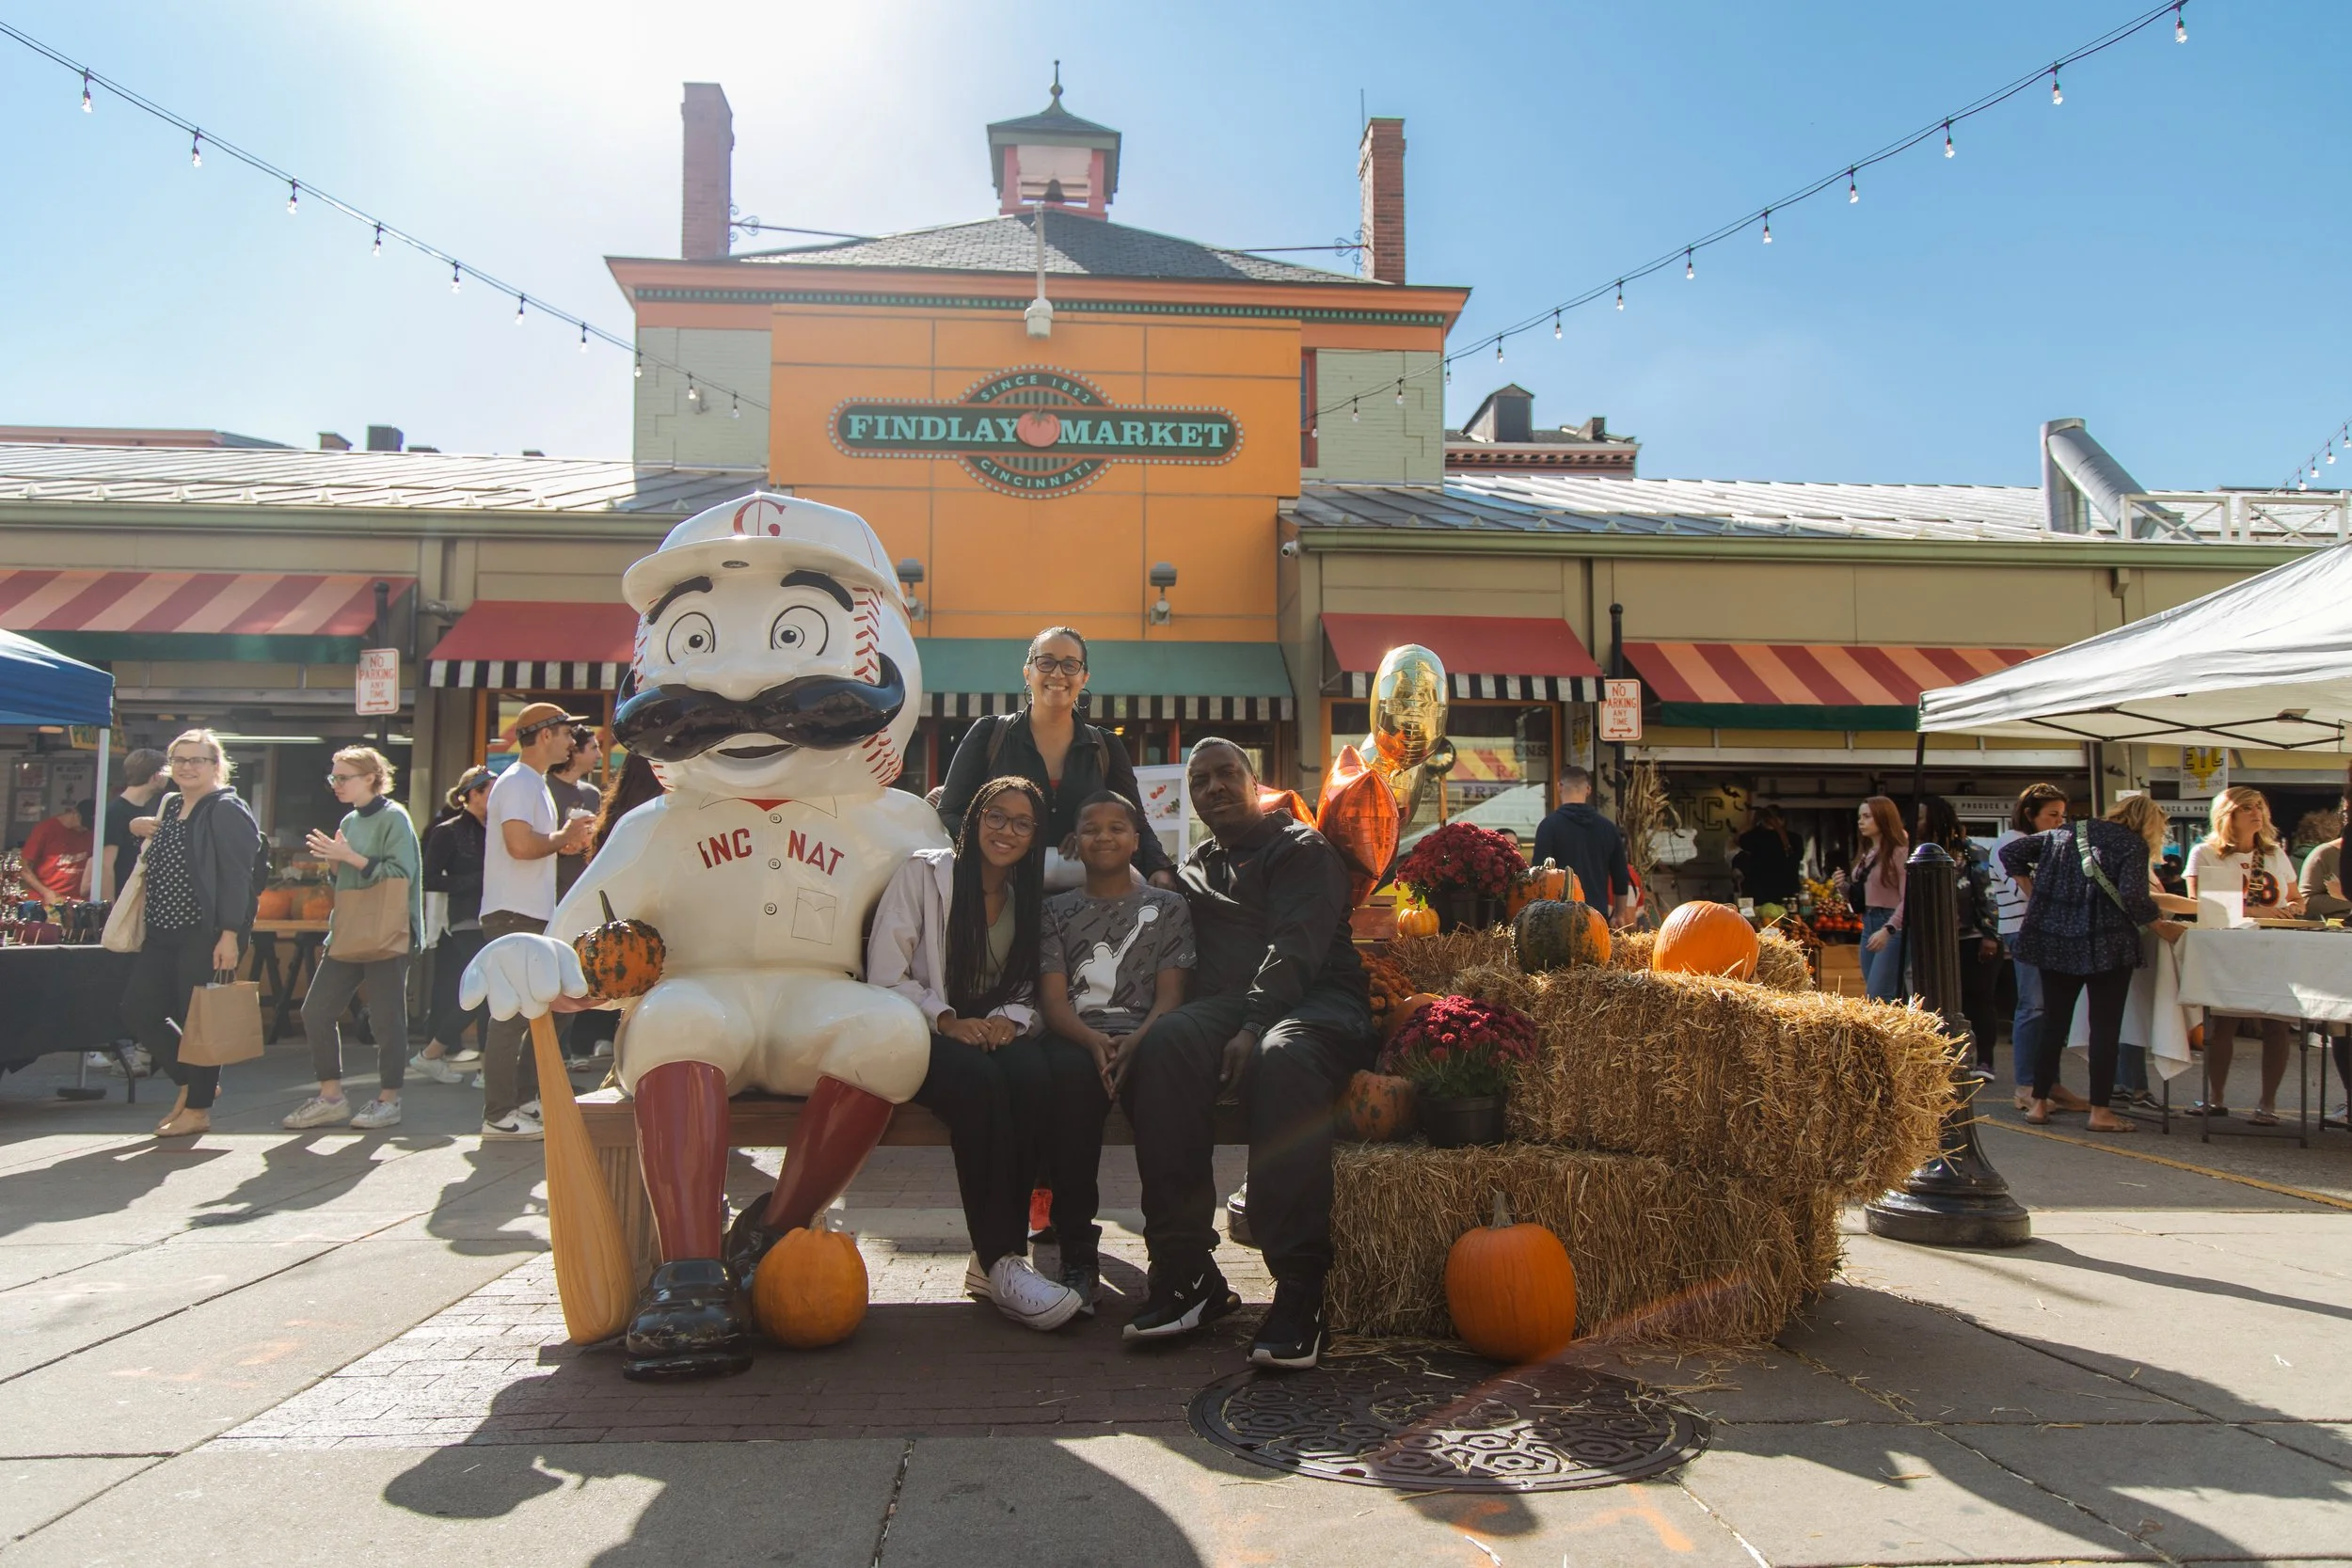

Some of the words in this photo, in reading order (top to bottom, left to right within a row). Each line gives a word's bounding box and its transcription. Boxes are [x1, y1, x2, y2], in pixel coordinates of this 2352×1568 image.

[980, 374, 1039, 403] SINCE
[1051, 378, 1092, 404] 1852
[847, 414, 1019, 443] FINDLAY
[1056, 419, 1229, 449] MARKET
[979, 459, 1092, 489] CINCINNATI
[370, 657, 384, 668] NO
[358, 668, 394, 681] PARKING
[370, 689, 385, 698] TIME
[1612, 686, 1627, 697] NO
[1601, 697, 1637, 709] PARKING
[1675, 796, 1724, 832] TC
